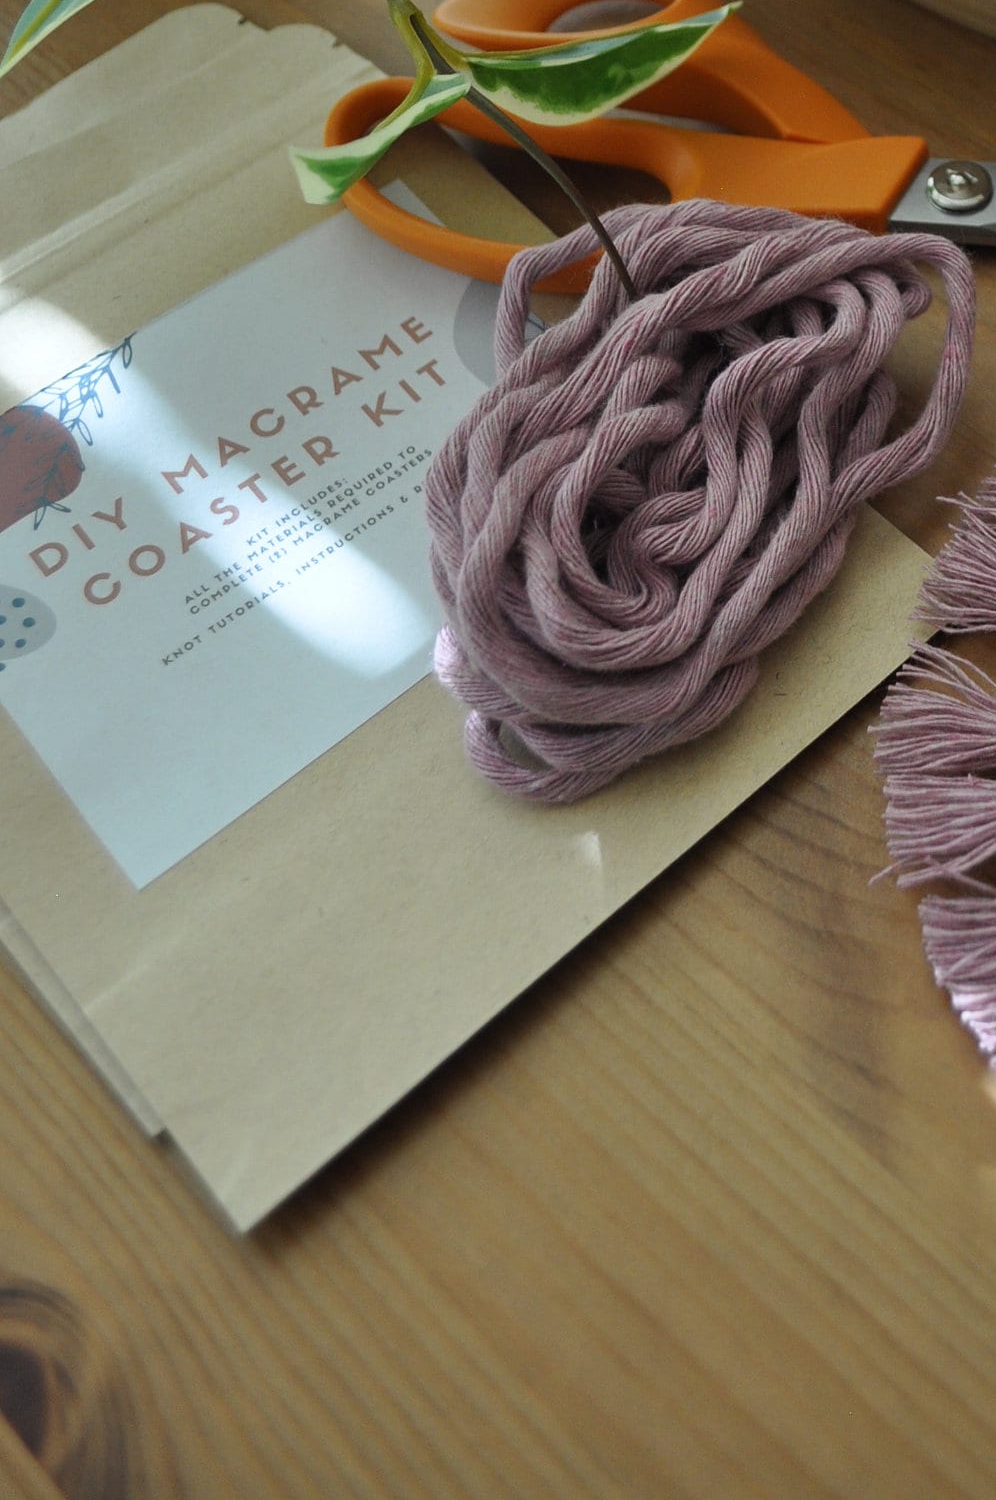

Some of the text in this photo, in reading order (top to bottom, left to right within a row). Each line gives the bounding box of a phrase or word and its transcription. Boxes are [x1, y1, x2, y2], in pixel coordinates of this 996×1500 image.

[29, 316, 433, 577] DIY MACRAME
[83, 359, 447, 606] COASTER KIT
[185, 445, 416, 604] ALL THE MATERIALS REQUIRED TO
[162, 635, 202, 666] KNOT
[295, 504, 395, 575] INSTRUCTIONS
[190, 564, 263, 615] COMPLETE
[293, 498, 360, 546] MACRAME
[366, 449, 432, 497] COASTERS
[247, 528, 269, 546] KIT
